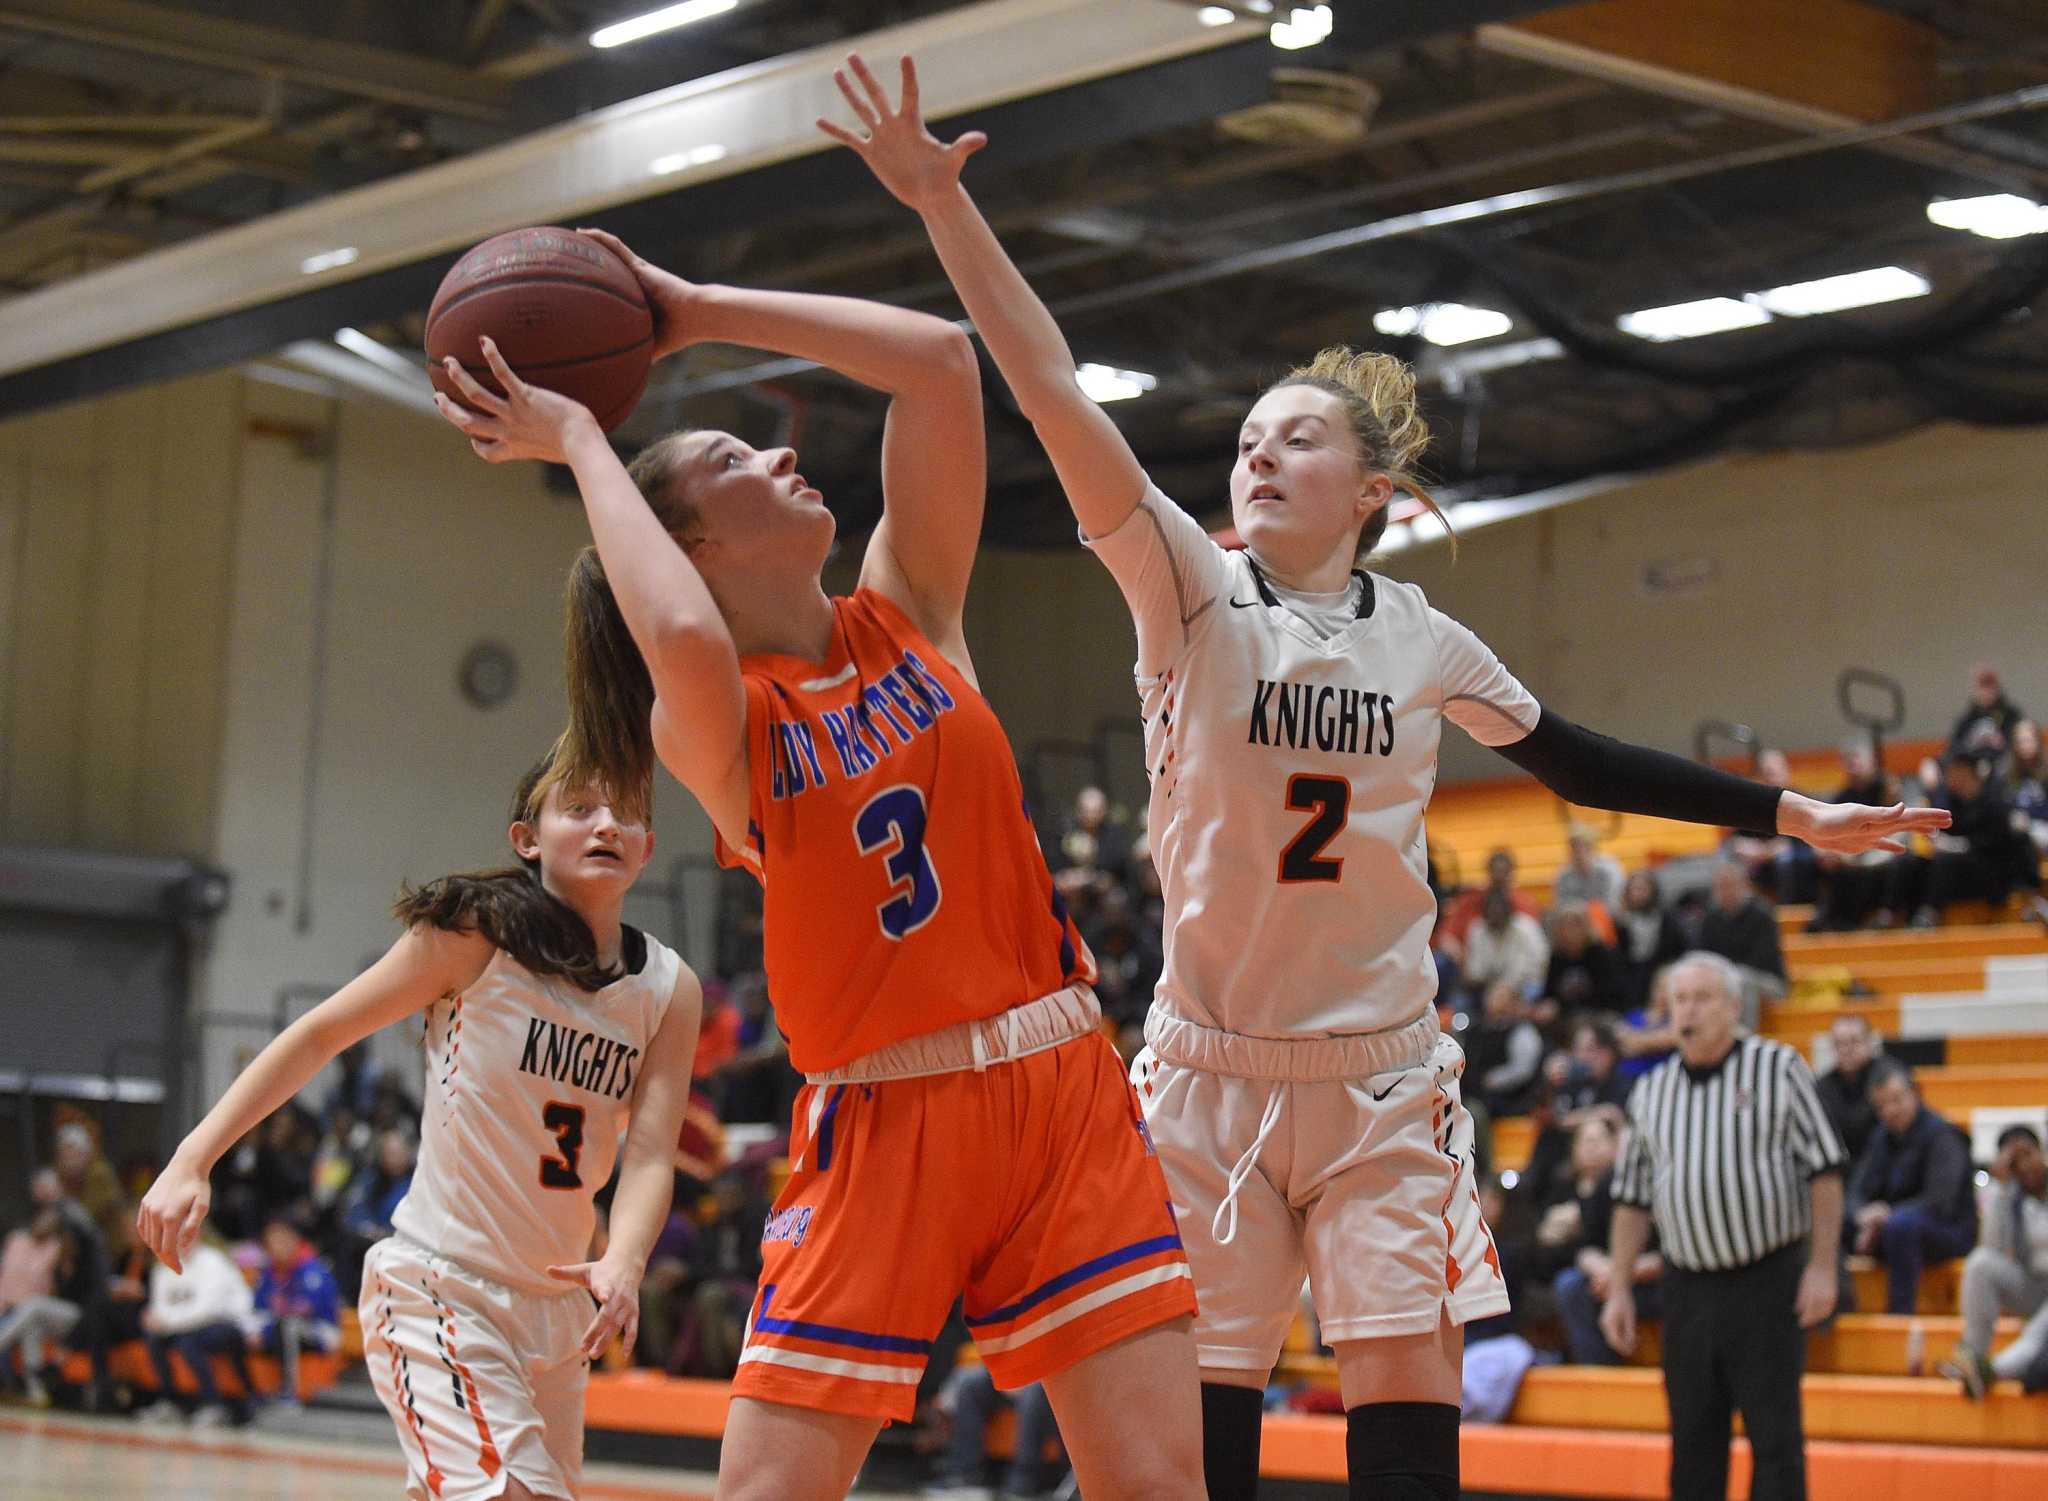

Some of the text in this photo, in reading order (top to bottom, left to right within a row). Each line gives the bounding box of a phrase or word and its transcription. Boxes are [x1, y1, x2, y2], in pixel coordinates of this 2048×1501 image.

[769, 719, 828, 800] LDY
[1248, 679, 1395, 756] KNIGHTS
[853, 784, 942, 941] 3
[1277, 772, 1351, 884] 2
[519, 1017, 639, 1100] KNIGHTS
[539, 1100, 585, 1191] 3
